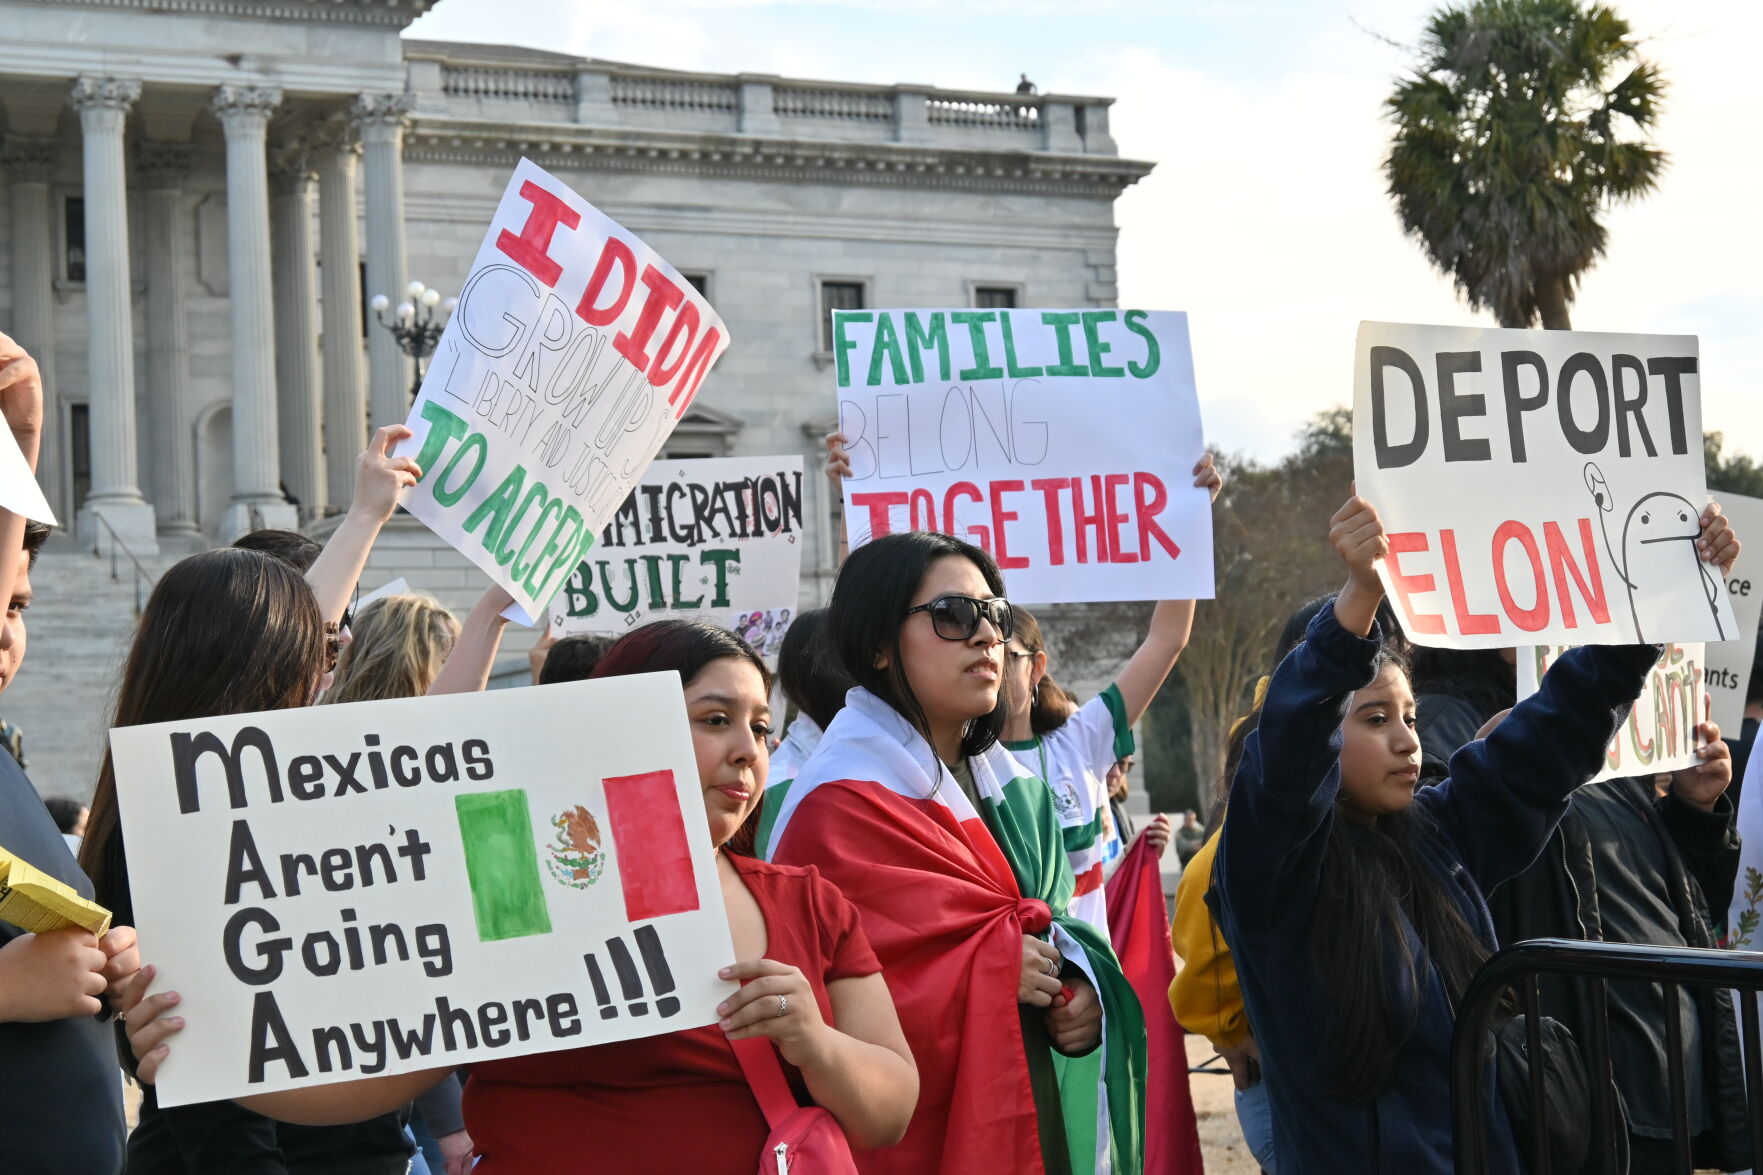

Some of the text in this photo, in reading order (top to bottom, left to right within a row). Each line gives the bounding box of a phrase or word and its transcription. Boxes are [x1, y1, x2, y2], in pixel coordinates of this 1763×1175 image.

[496, 179, 581, 288] I
[457, 263, 626, 430] GROW
[594, 366, 654, 458] UP
[835, 308, 1161, 387] FAMILIES
[532, 420, 571, 468] AND
[840, 378, 1049, 481] BELONG
[1370, 345, 1698, 469] DEPORT
[415, 399, 488, 508] TO
[602, 471, 803, 547] MIGRATION
[851, 471, 1181, 570] TOGETHER
[563, 548, 741, 617] BUILT
[1385, 518, 1612, 636] ELON
[1723, 577, 1751, 596] ce
[170, 725, 495, 815] Mexicas
[223, 819, 431, 905] Aren't
[222, 907, 454, 987] Going
